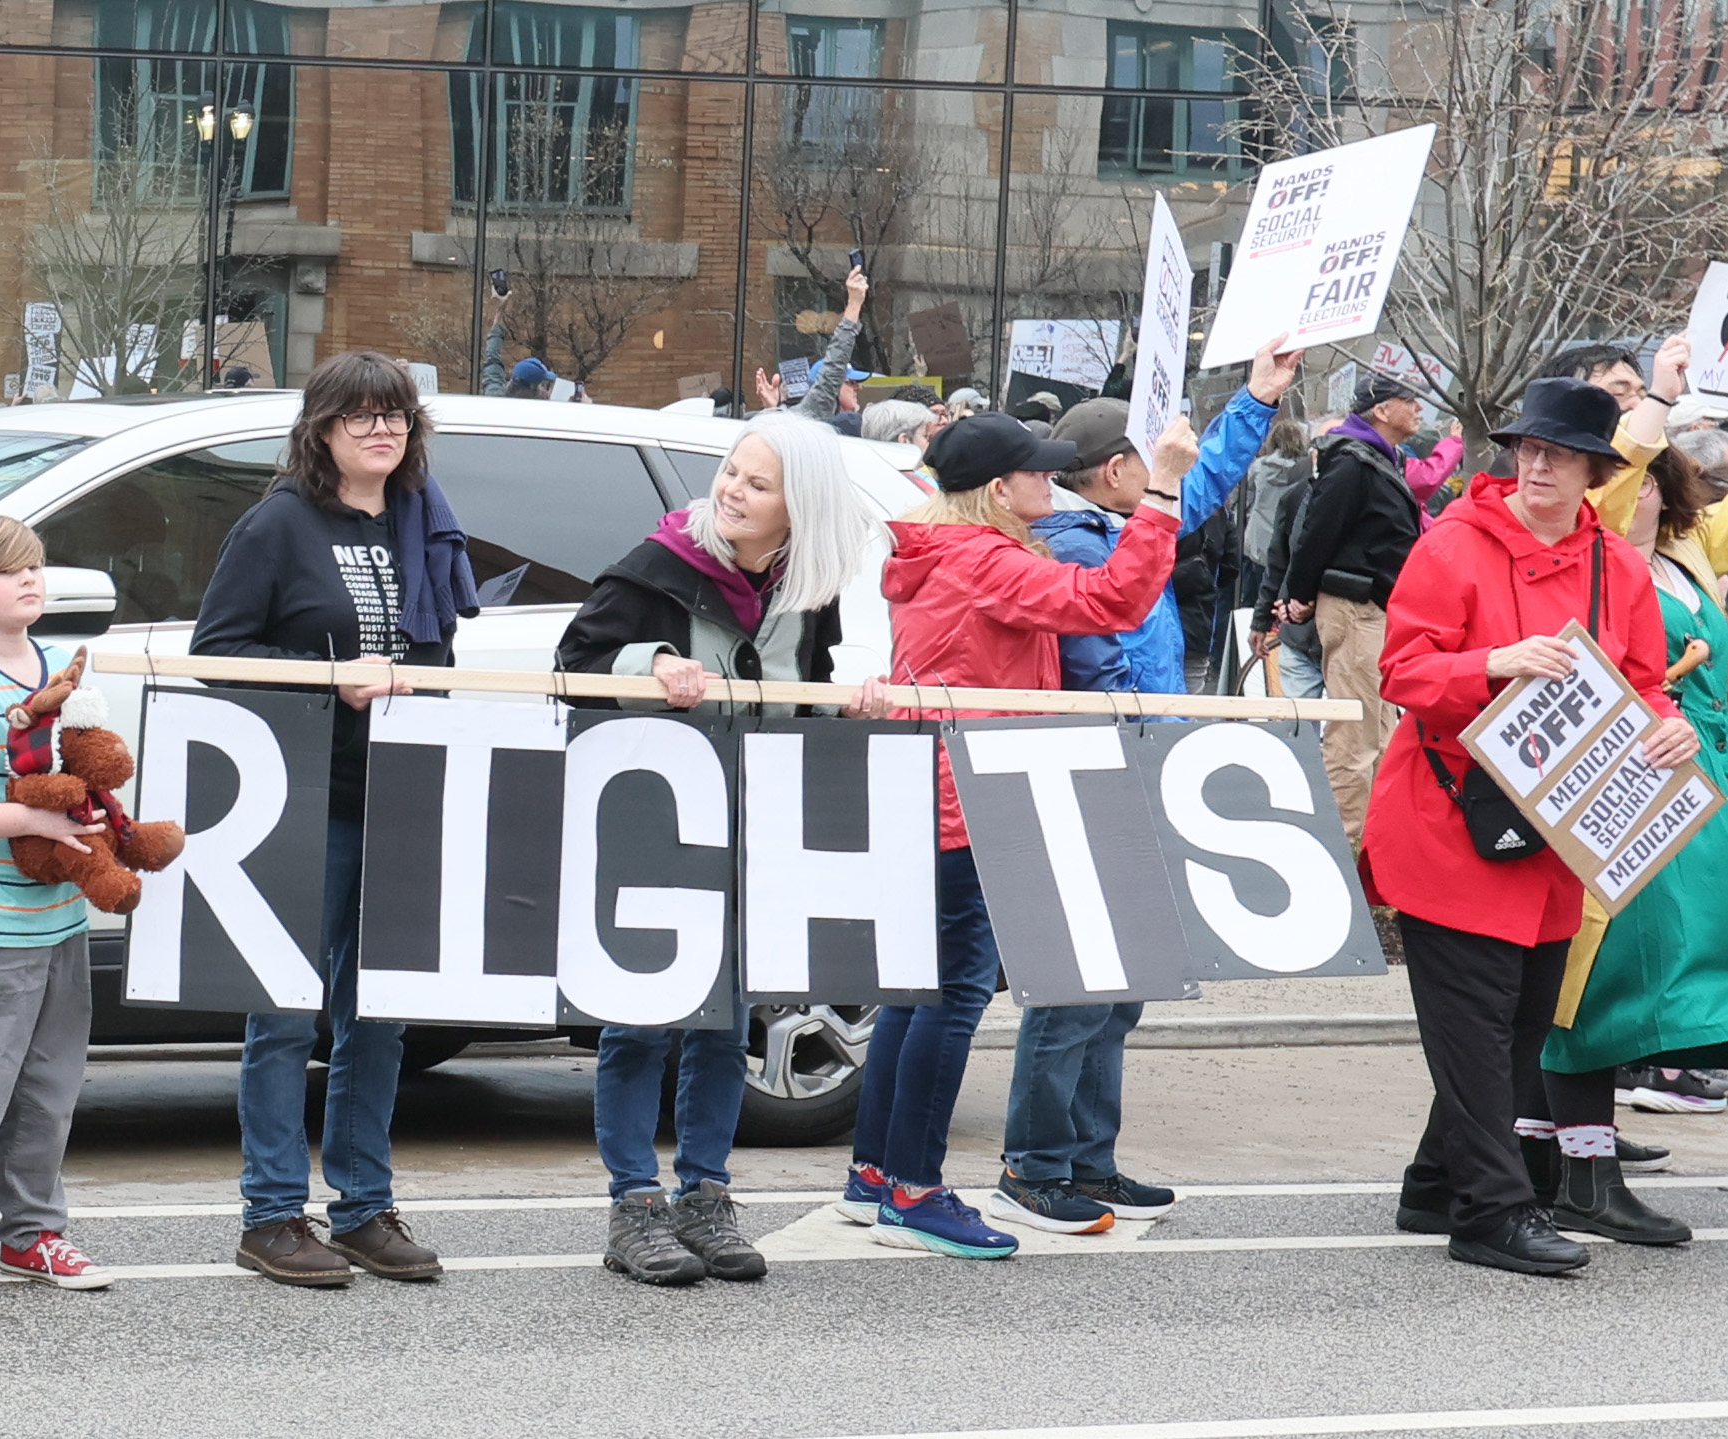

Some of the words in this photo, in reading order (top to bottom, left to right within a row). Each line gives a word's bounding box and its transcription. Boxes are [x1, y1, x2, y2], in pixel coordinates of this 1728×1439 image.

[1272, 165, 1334, 189] HANDS
[1267, 179, 1330, 209] OFF!
[1255, 204, 1322, 235] SOCIAL
[1250, 222, 1321, 250] SECURITY
[1324, 231, 1386, 254] HANDS
[1319, 245, 1383, 274] OFF!
[1304, 271, 1376, 311] FAIR
[1299, 300, 1368, 325] ELECTIONS
[1500, 668, 1579, 748] HANDS
[1518, 679, 1603, 770] OFF!
[1548, 715, 1635, 812] MEDICAID
[1579, 754, 1652, 838] SOCIAL
[1596, 768, 1664, 849] SECURITY
[1495, 839, 1526, 851] adidas
[1607, 787, 1700, 887] MEDICARE
[127, 690, 1353, 1027] RIGHTS
[881, 1205, 904, 1226] HOKA
